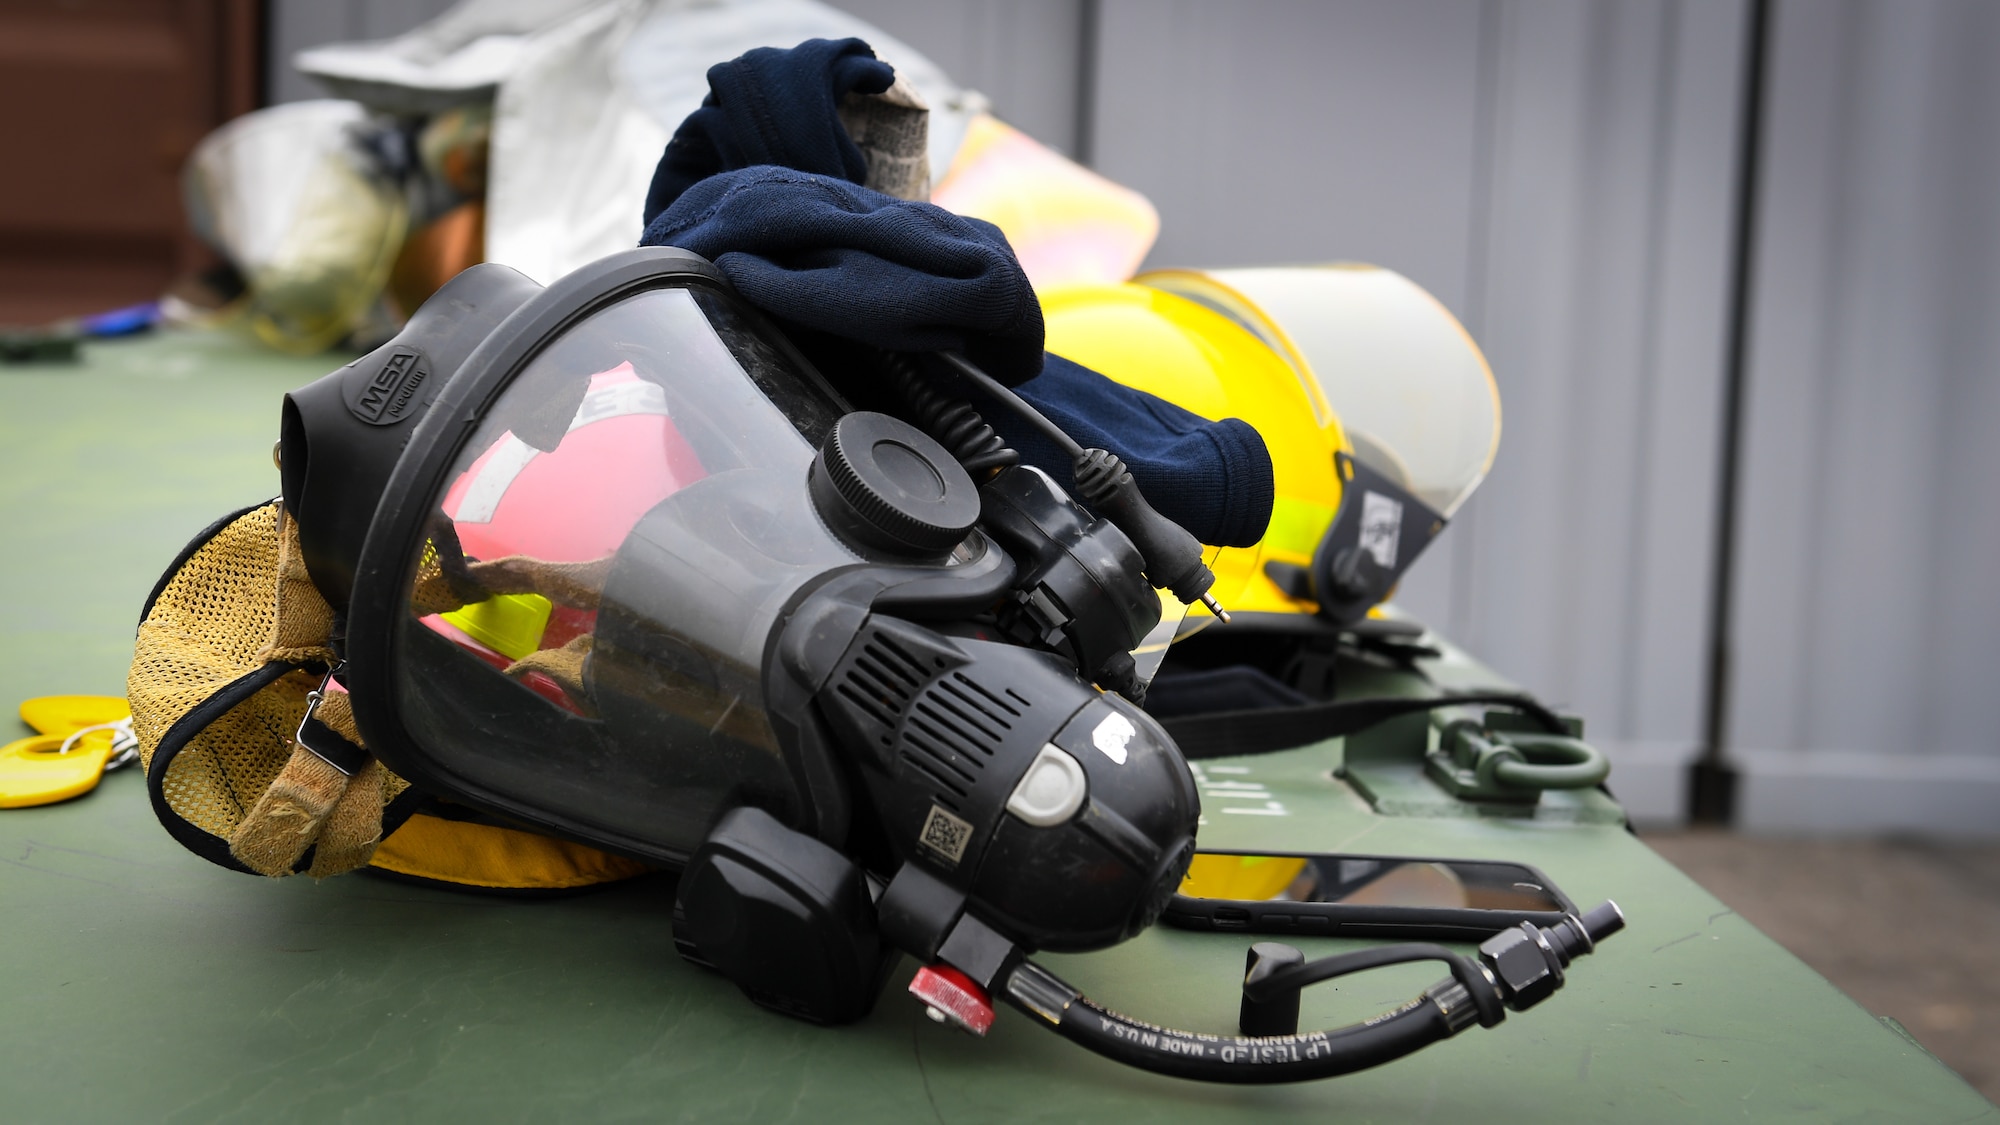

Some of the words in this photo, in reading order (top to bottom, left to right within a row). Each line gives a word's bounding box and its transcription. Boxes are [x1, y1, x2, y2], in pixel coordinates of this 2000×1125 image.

[360, 354, 414, 414] MSA
[387, 370, 427, 418] Medium
[1141, 1033, 1157, 1048] IN
[1160, 1038, 1205, 1056] MADE
[1305, 1041, 1331, 1059] LP
